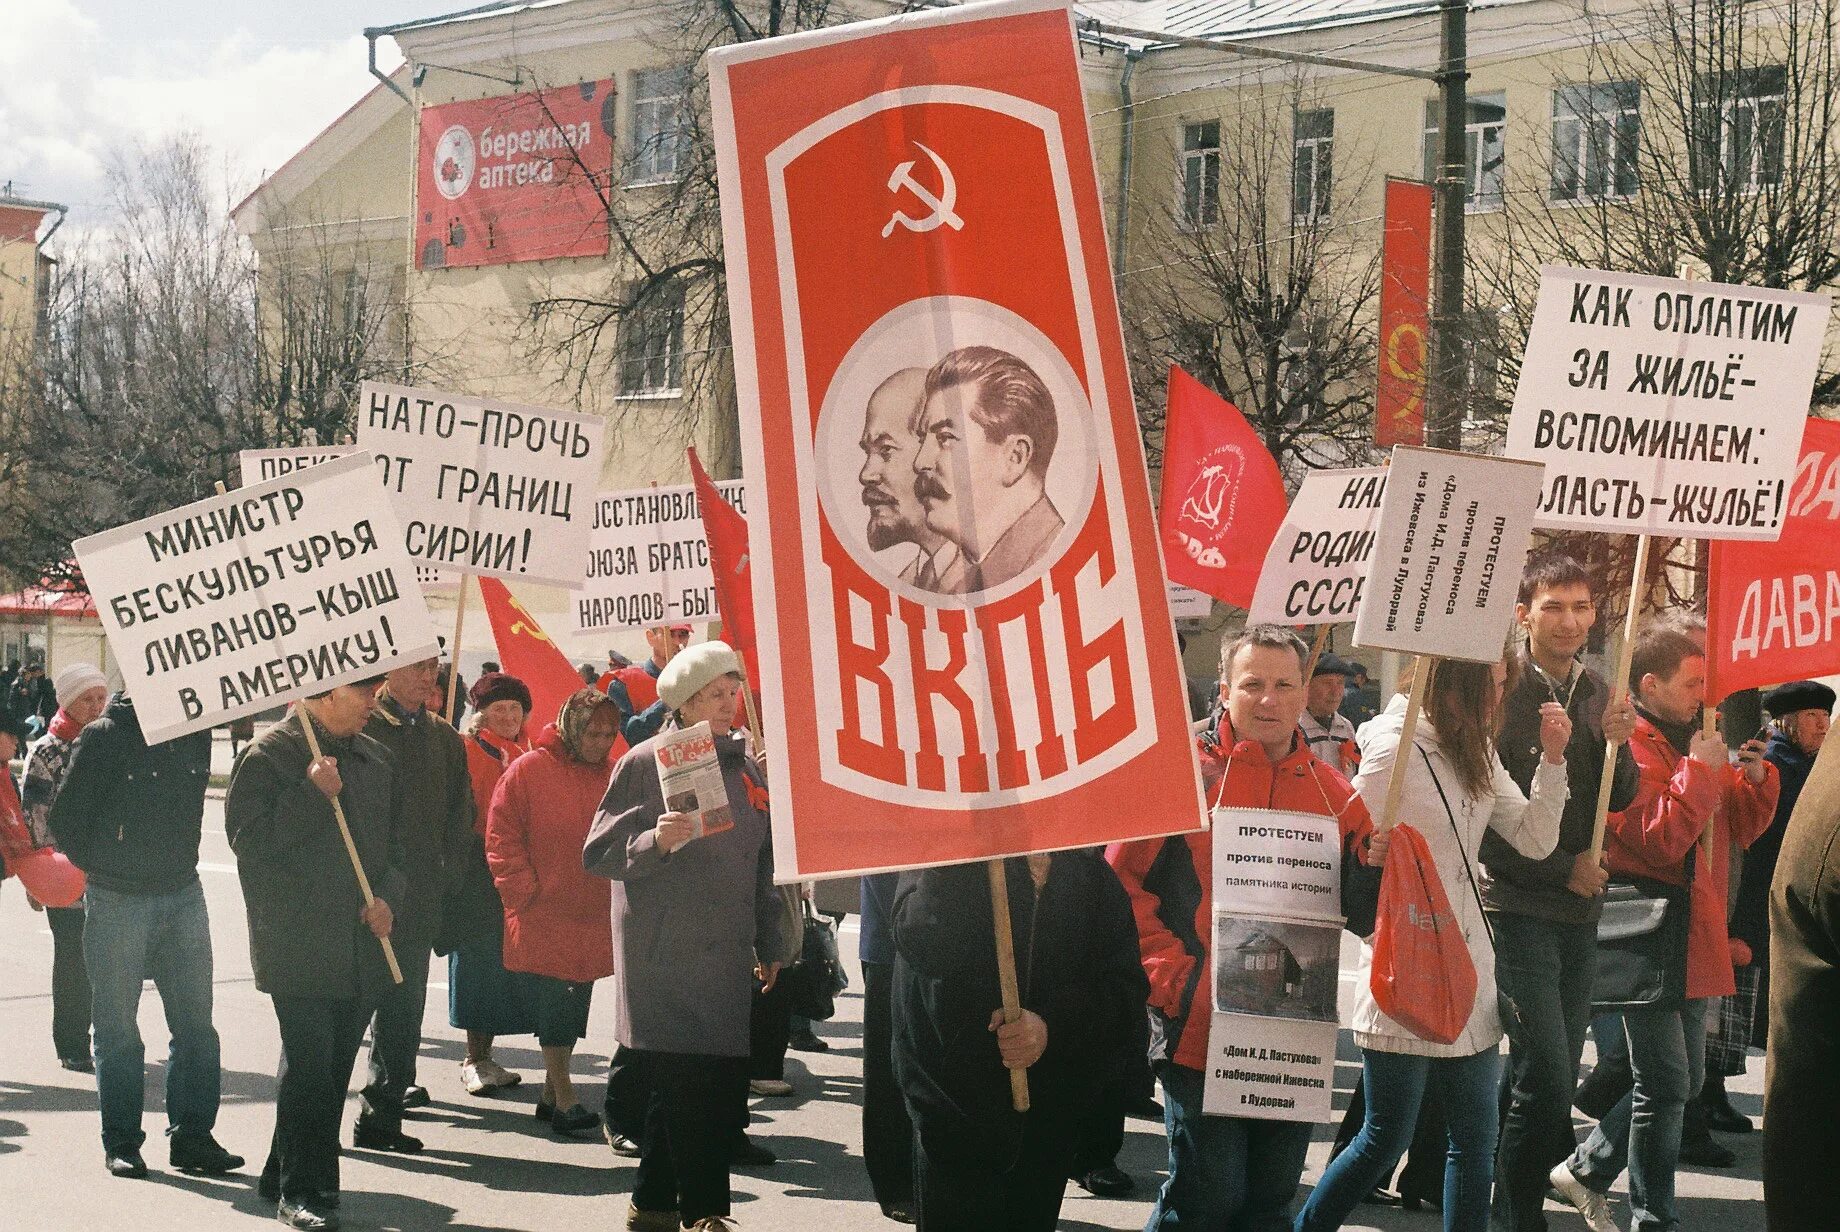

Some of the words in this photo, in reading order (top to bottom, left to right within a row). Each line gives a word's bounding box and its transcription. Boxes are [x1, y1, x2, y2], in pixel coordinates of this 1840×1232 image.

[480, 121, 591, 161] бережная
[480, 161, 554, 189] аптека
[1569, 282, 1634, 329] КАК
[1653, 291, 1799, 345] ОПЛАТИМ
[1567, 347, 1610, 391] ЗА
[368, 392, 590, 459] НАТО-ПРОЧЬ
[1533, 408, 1766, 466] ВСПОМИНАЕМ:
[437, 464, 572, 522] ГРАНИЦ
[1417, 470, 1429, 489] из
[1439, 474, 1457, 519] «Дома
[1535, 474, 1785, 528] ЛАСТЬ-ЖУЛЬЁ!
[144, 487, 304, 563] МИНИСТР
[405, 520, 532, 573] СИРИИ!
[1403, 491, 1426, 554] Ижевска
[1430, 522, 1448, 552] И.Д.
[1460, 499, 1479, 549] против
[109, 519, 379, 630] БЕСКУЛЬТУРЬЯ
[648, 539, 709, 573] БРАТС
[1401, 556, 1410, 566] в
[1445, 549, 1467, 615] переноса
[1474, 515, 1506, 609] ПРОТЕСТУЕМ
[1385, 566, 1409, 632] Лудорвай
[1413, 554, 1440, 633] Пастухова»
[145, 567, 400, 677] ЛИВАНОВ-КЫШ
[178, 687, 203, 721] В
[219, 615, 399, 710] АМЕРИКУ!
[818, 518, 1138, 793] ВКПБ
[1238, 825, 1324, 844] ПРОТЕСТУЕМ
[1225, 876, 1289, 891] памятника
[1291, 881, 1332, 896] истории
[1226, 852, 1273, 865] против
[1277, 854, 1332, 871] переноса
[1215, 1068, 1222, 1079] с
[1222, 1068, 1282, 1085] набережной
[1282, 1073, 1326, 1090] Ижевска
[1240, 1094, 1247, 1105] в
[1247, 1093, 1296, 1109] Лудорвай
